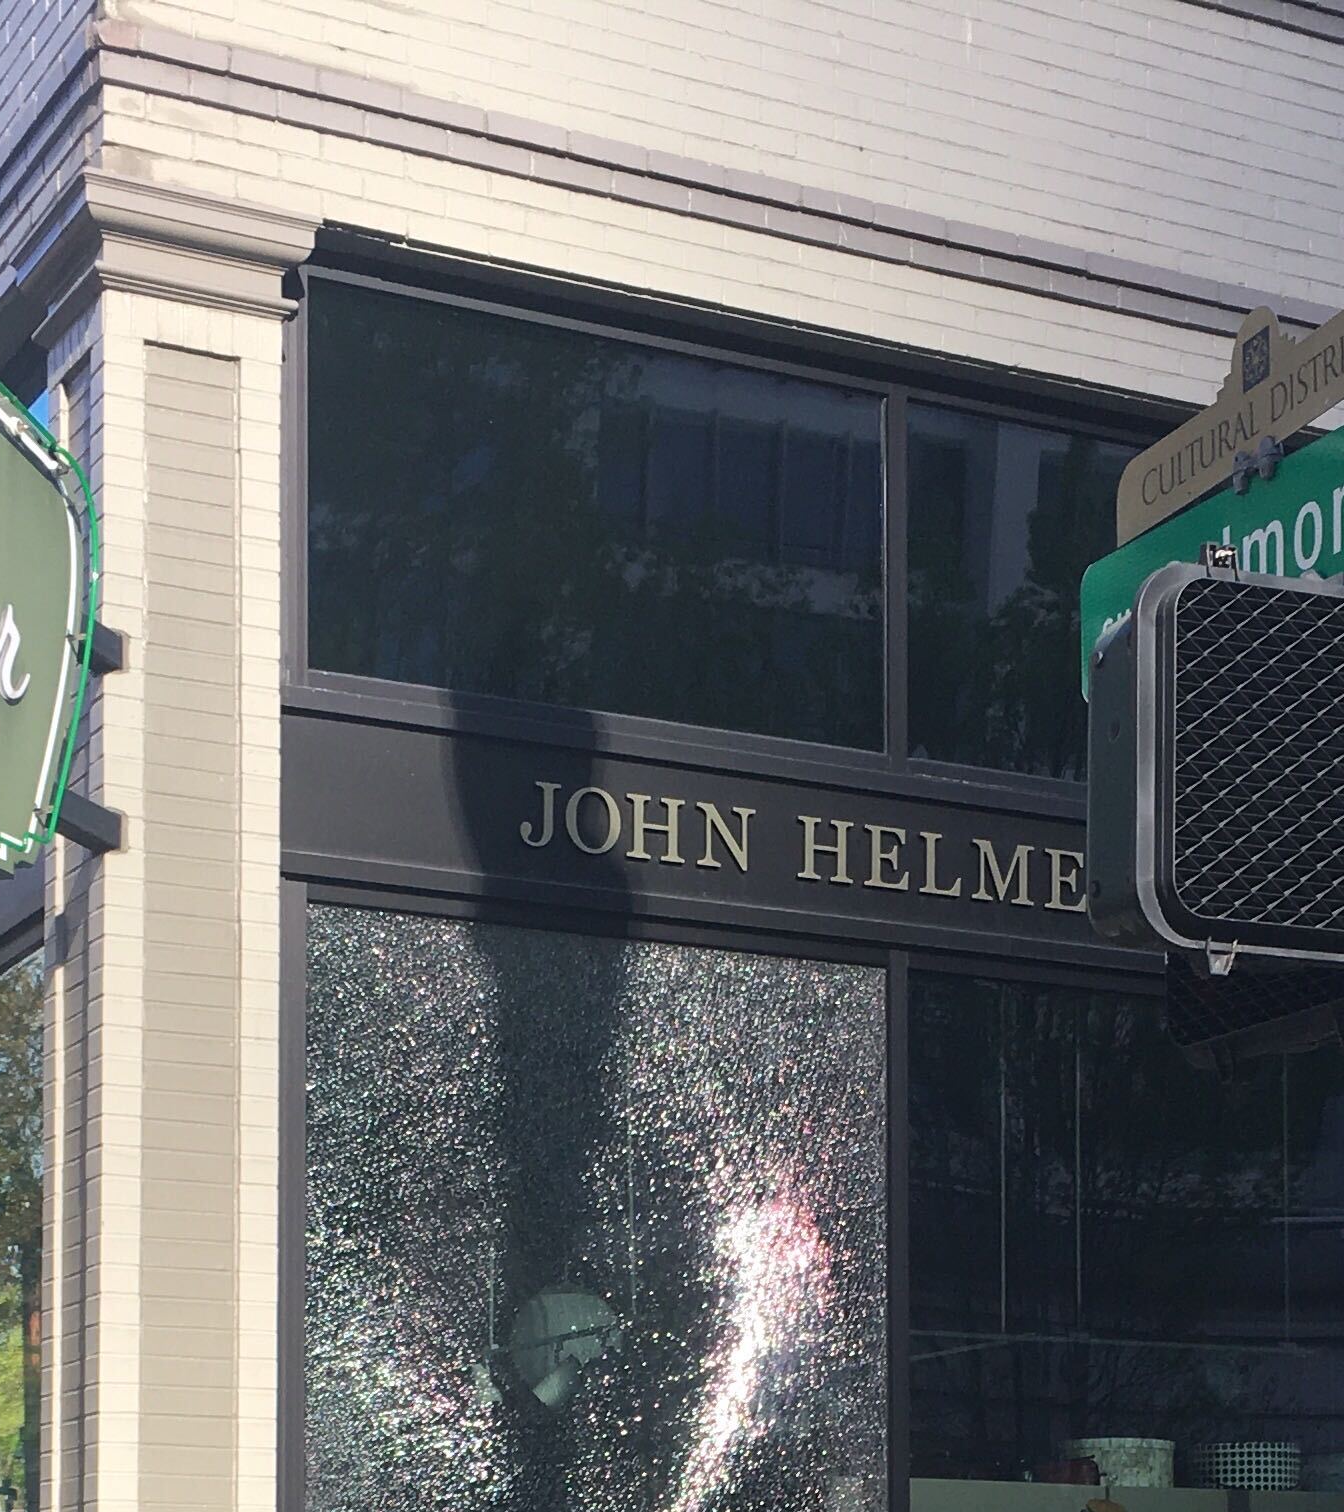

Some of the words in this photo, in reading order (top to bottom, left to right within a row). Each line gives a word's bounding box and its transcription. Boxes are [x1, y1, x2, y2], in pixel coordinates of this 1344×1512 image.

[1141, 401, 1261, 507] CULTURAL
[519, 781, 756, 873] JOHN
[796, 814, 1088, 913] HELME
